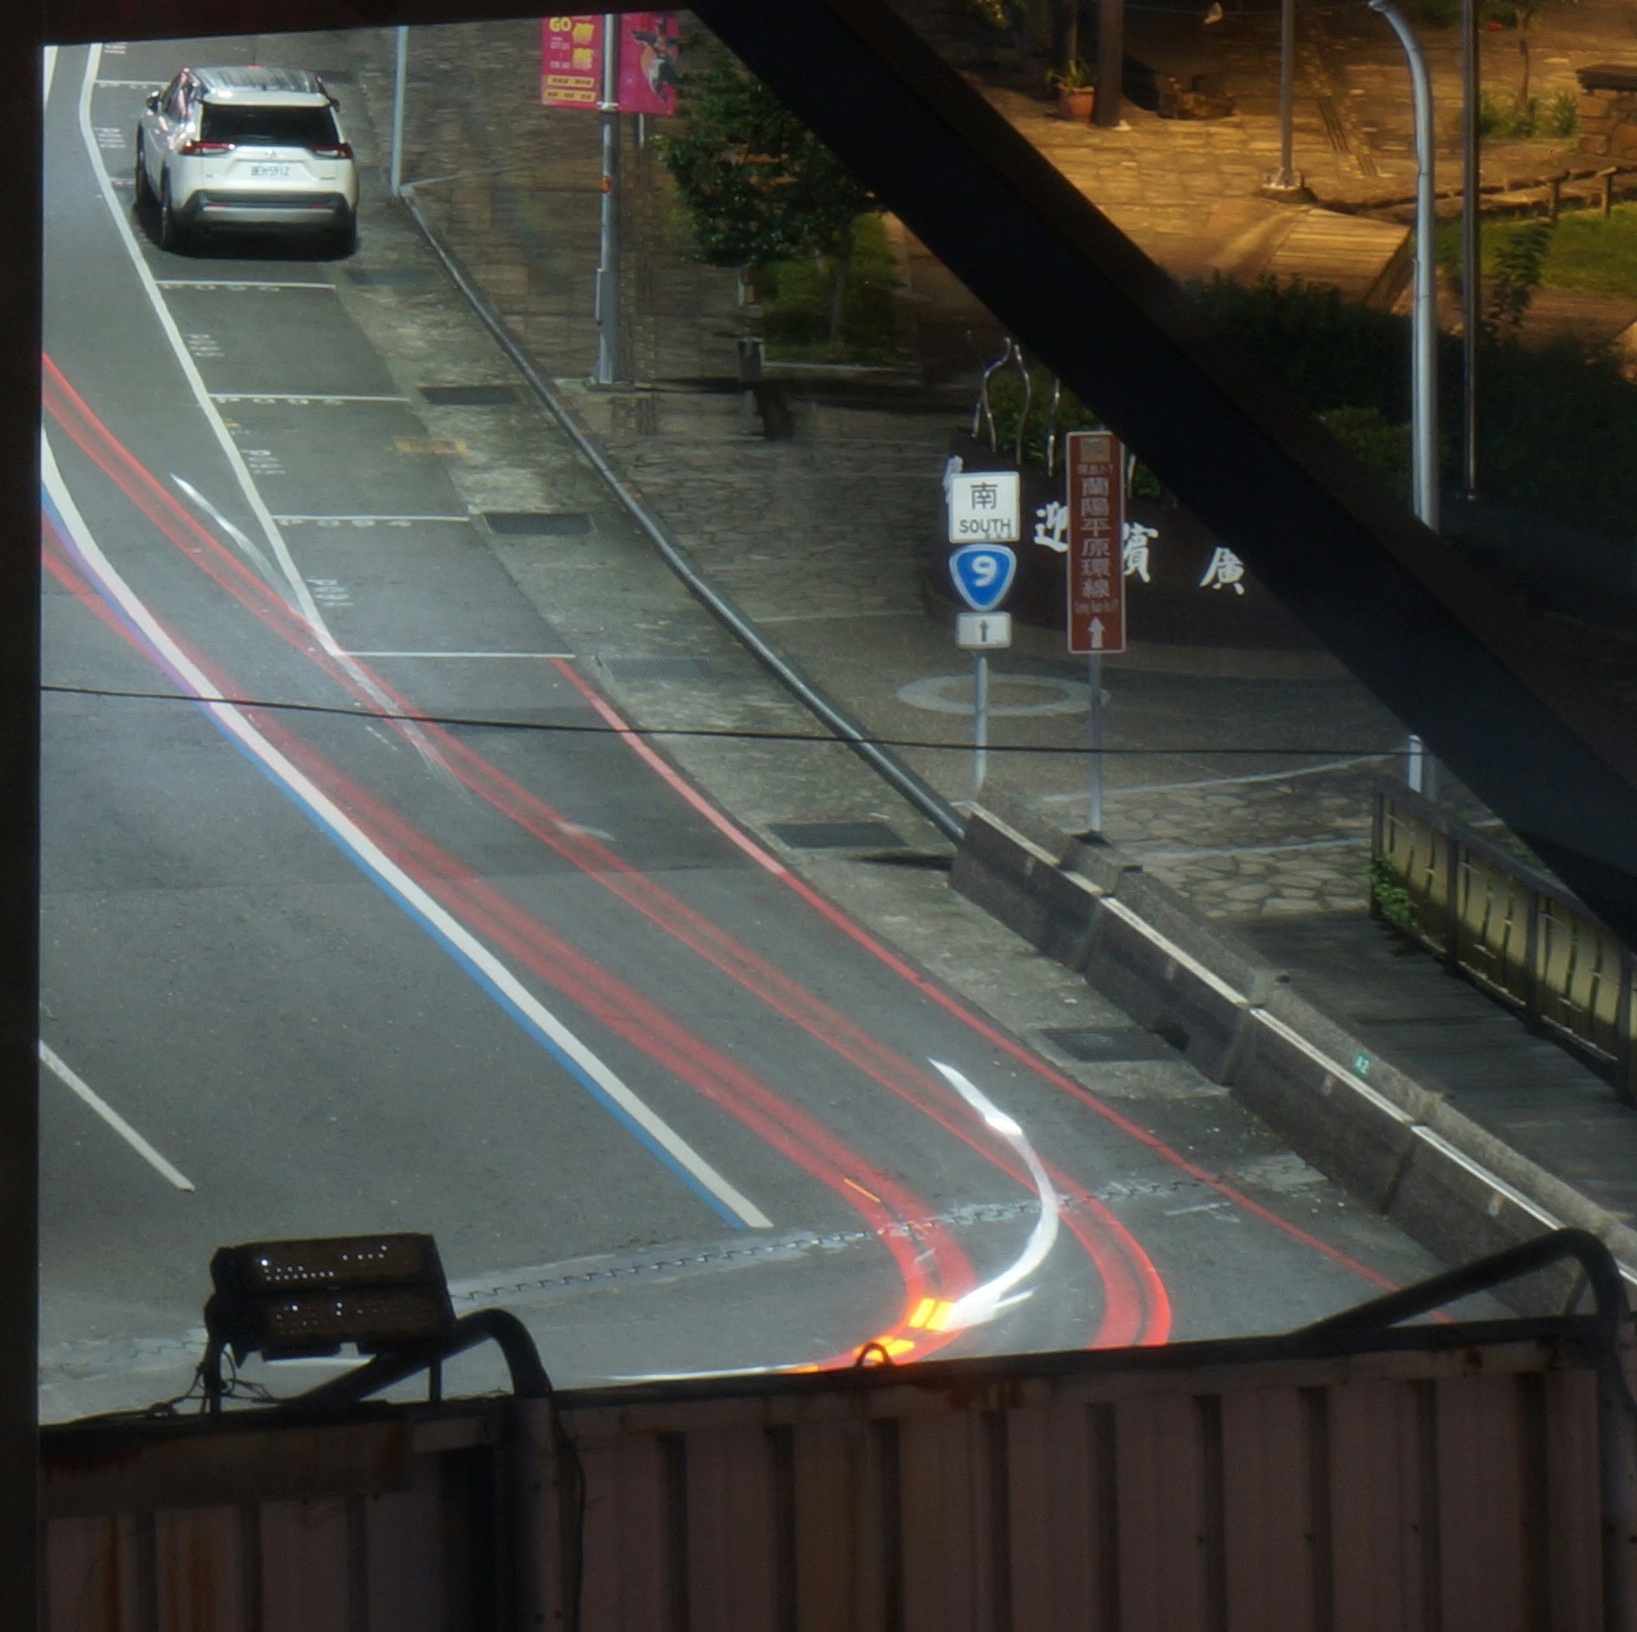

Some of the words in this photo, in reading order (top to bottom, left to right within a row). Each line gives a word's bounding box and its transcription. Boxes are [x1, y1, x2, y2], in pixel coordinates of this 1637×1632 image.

[970, 482, 998, 511] 南
[959, 518, 1012, 534] SOUTH
[1079, 476, 1112, 599] 蘭陽平原環線
[971, 555, 997, 588] 9
